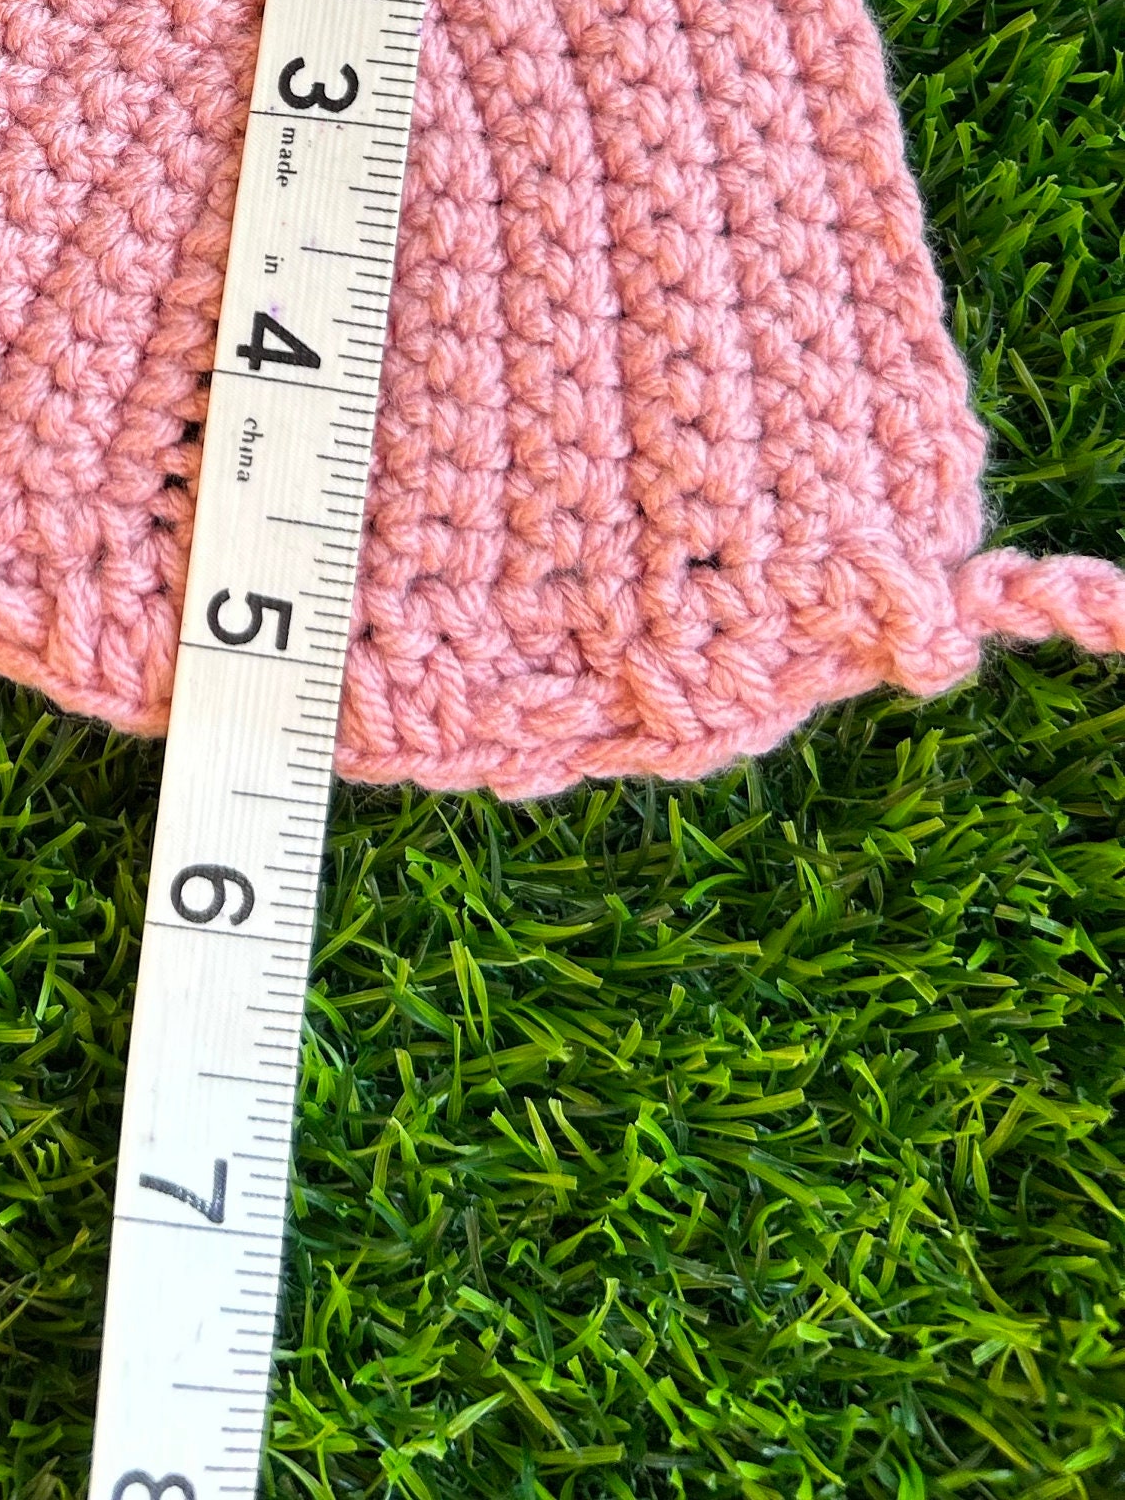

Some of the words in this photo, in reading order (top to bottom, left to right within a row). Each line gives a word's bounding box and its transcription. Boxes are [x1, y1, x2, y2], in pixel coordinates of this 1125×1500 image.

[278, 56, 359, 113] 3
[276, 126, 298, 188] made
[264, 253, 285, 275] in
[236, 311, 321, 371] 4
[236, 416, 264, 483] china
[206, 587, 293, 651] 5
[170, 863, 255, 926] 6
[139, 1158, 228, 1223] 7
